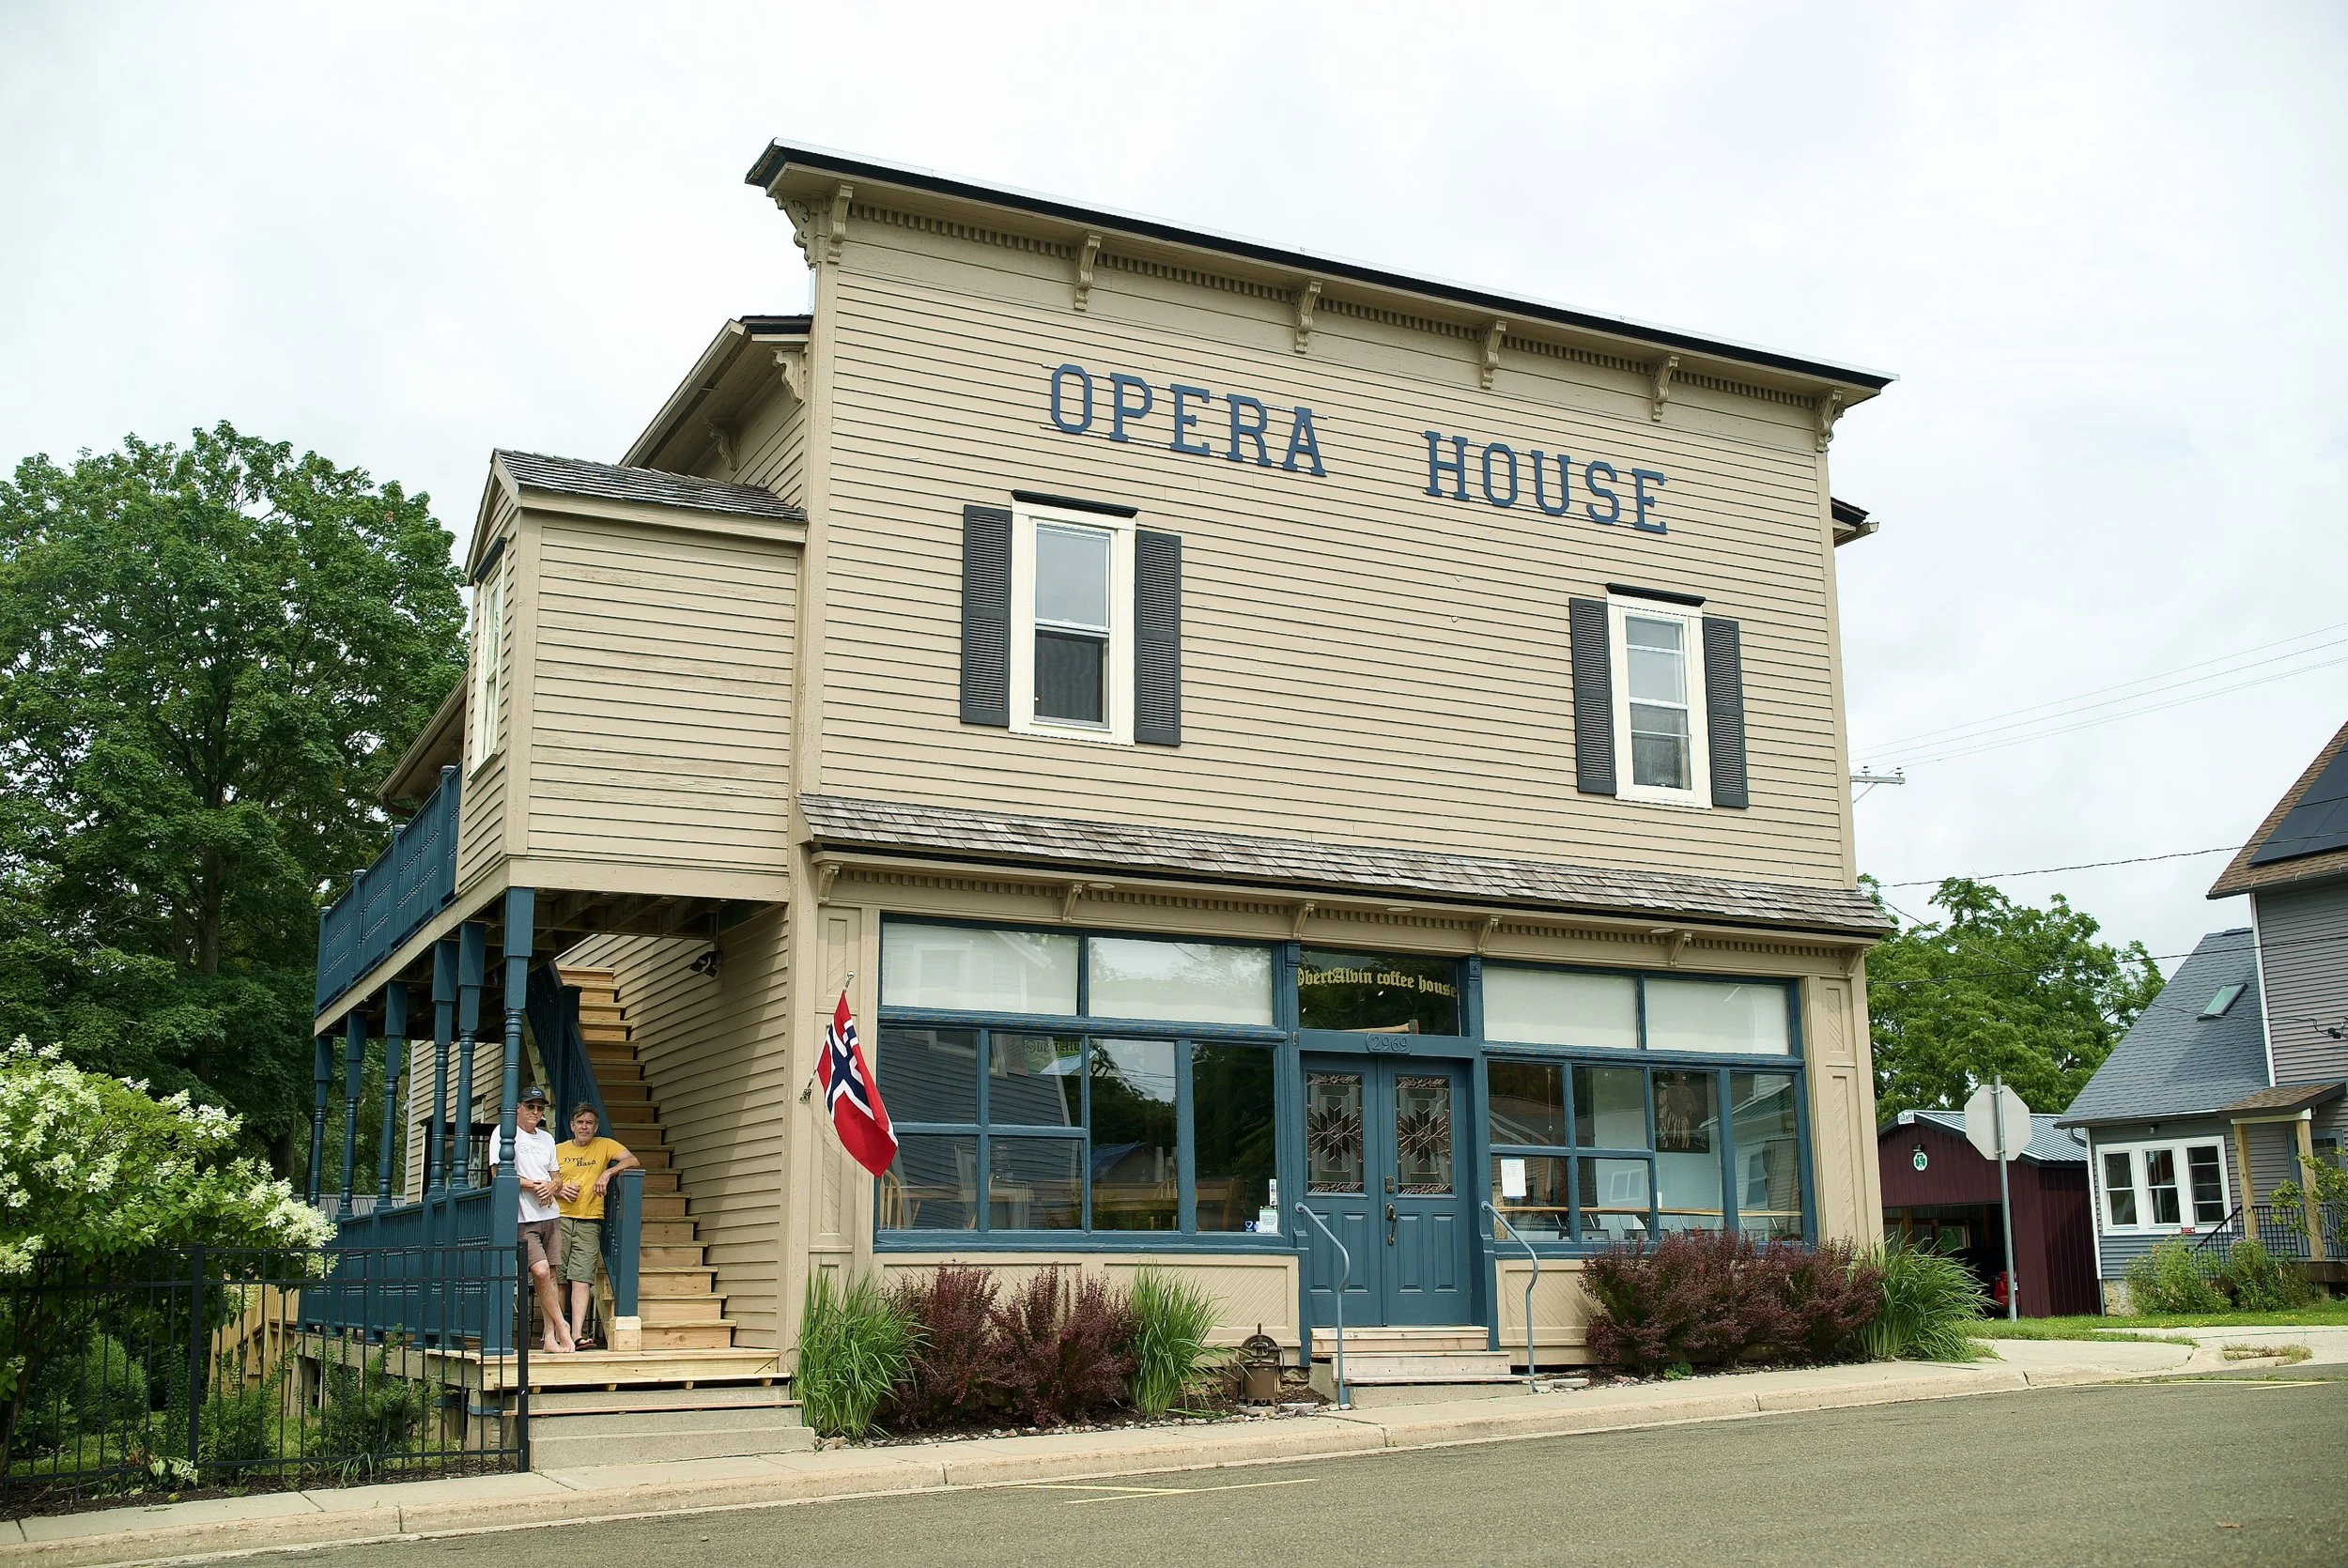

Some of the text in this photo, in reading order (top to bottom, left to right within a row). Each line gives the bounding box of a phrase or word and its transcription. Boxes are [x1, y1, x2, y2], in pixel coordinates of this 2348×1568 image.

[1051, 363, 1667, 534] OPERA HOUSE
[1377, 970, 1414, 989] coffee
[1418, 975, 1458, 998] house
[1371, 1036, 1409, 1052] 2969
